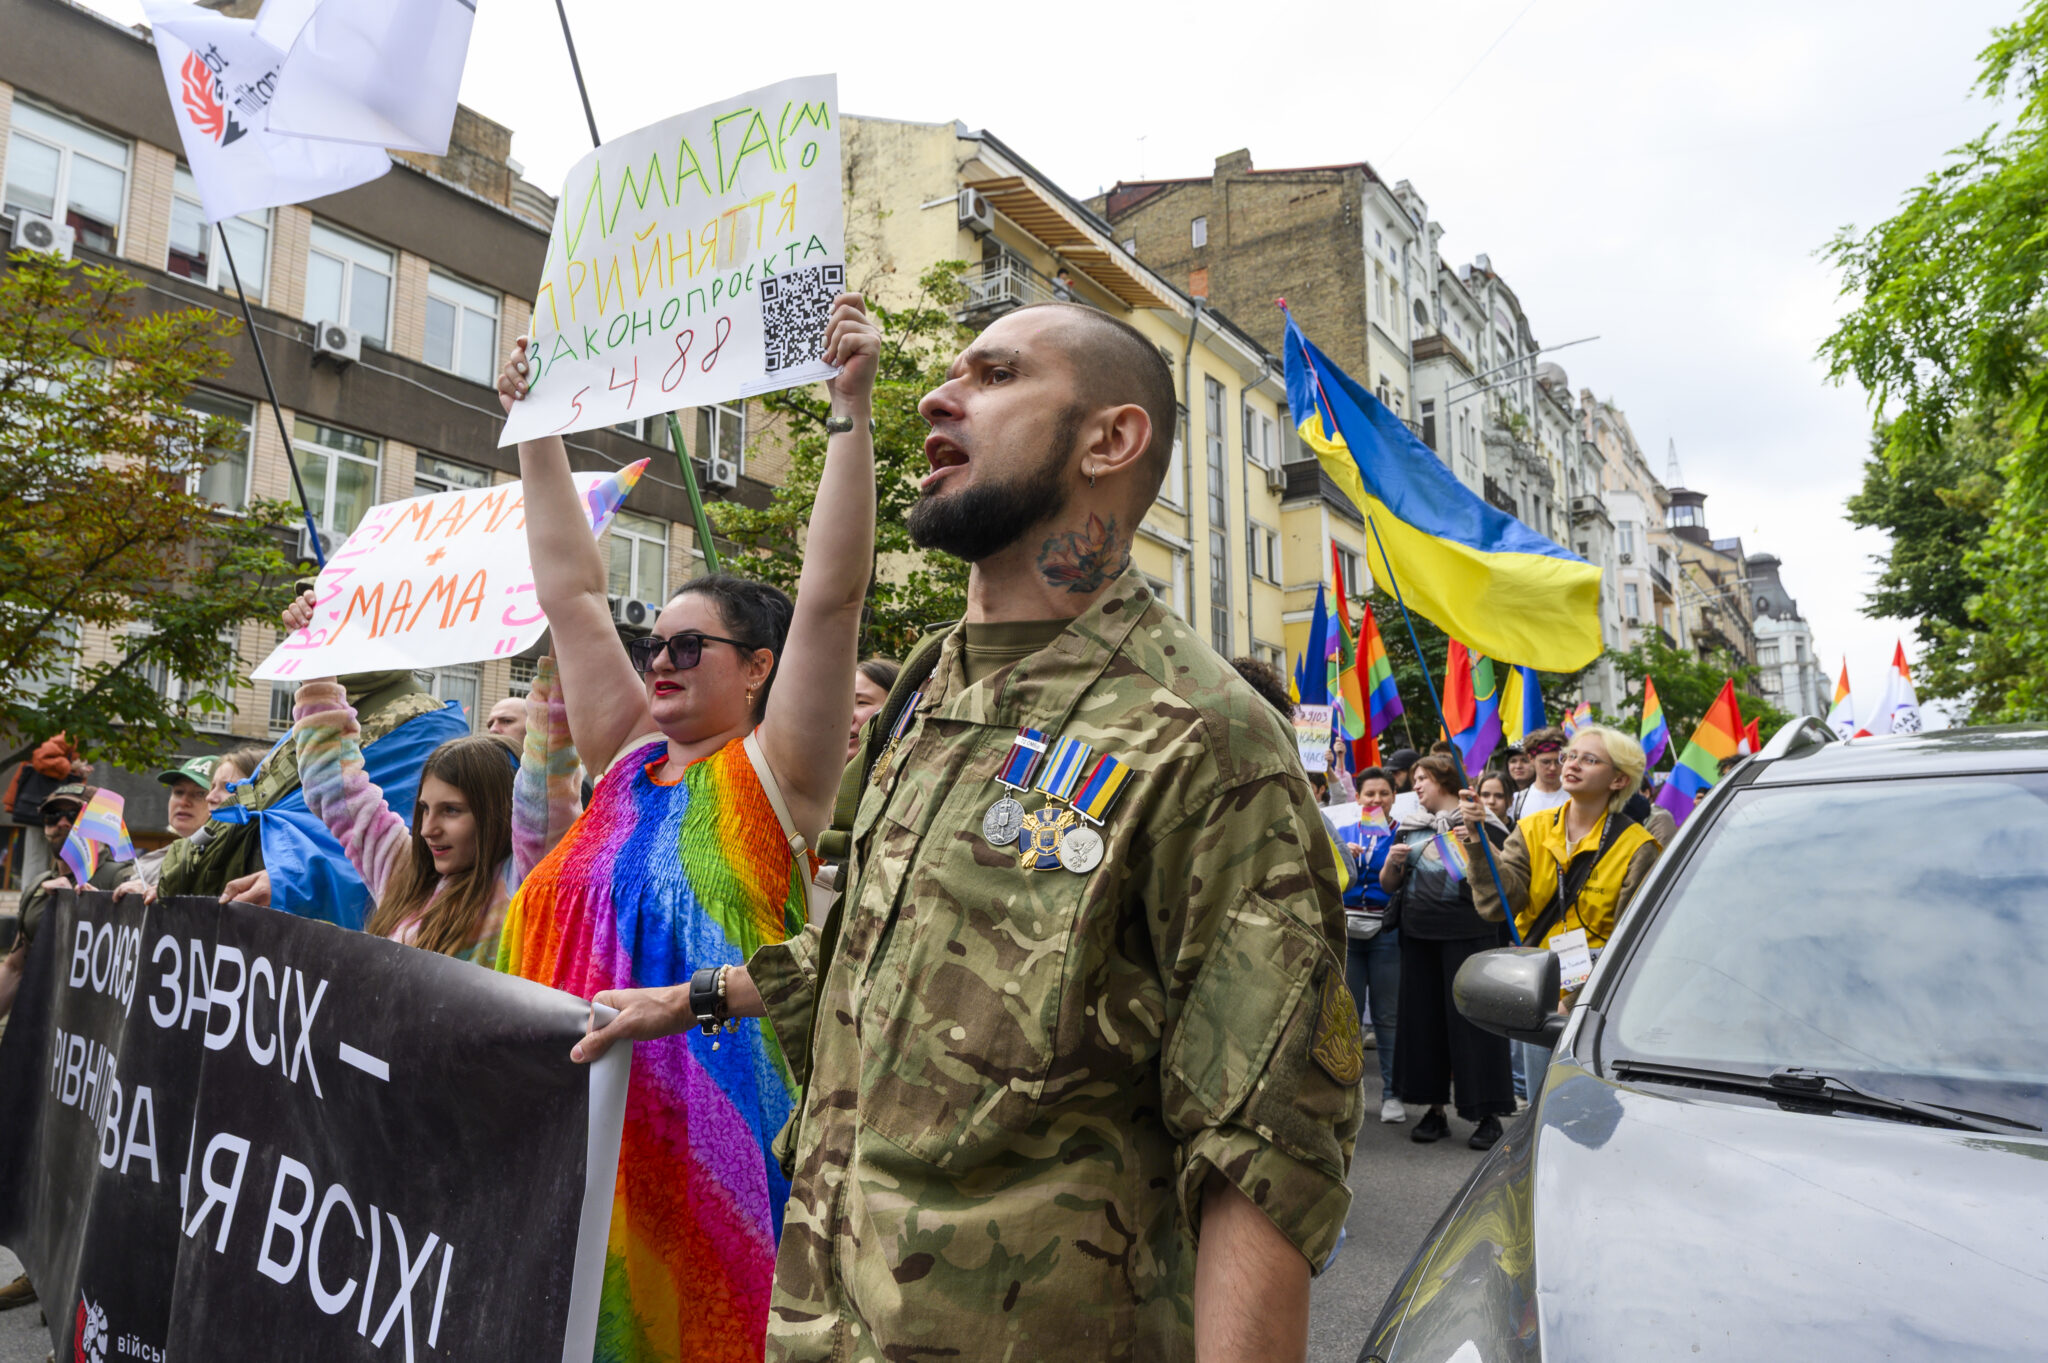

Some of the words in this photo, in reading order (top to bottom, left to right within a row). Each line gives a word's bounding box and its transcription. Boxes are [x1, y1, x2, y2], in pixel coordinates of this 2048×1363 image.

[532, 183, 798, 338] ПРИЙНЯТТЯ
[549, 316, 731, 434] 5488
[325, 568, 487, 646] МАМА
[203, 943, 329, 1099] ВСІХ
